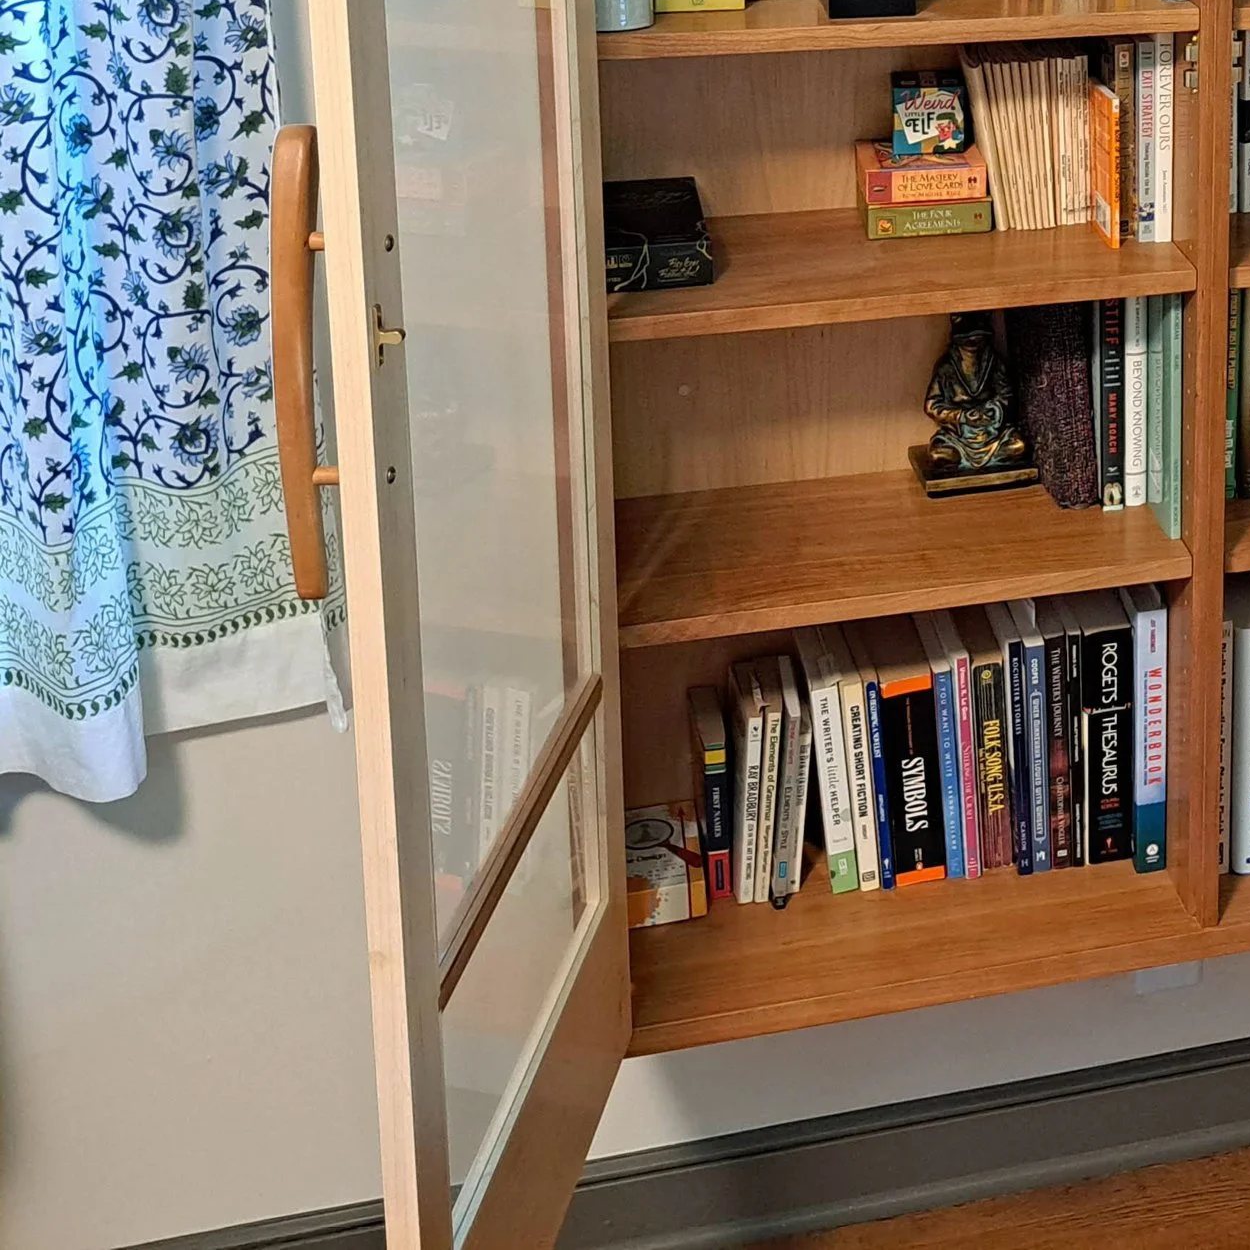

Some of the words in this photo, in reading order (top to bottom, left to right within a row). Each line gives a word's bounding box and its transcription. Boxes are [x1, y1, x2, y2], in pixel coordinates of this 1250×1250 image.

[1142, 70, 1153, 91] EXIT
[1158, 43, 1172, 114] FOREVER
[905, 91, 960, 111] Weird
[1142, 94, 1153, 139] STRATEGY
[905, 111, 935, 135] ELF
[1159, 114, 1173, 151] OURS
[1105, 299, 1119, 344] STIFF
[1132, 361, 1142, 407] BEYOND
[1108, 393, 1117, 419] MARY
[1109, 423, 1118, 454] ROACH
[1132, 411, 1142, 466] KNOWING
[819, 697, 829, 716] THE
[822, 718, 833, 763] WRITER'S
[850, 705, 862, 750] CREATING
[983, 719, 1000, 748] FOLK
[1148, 667, 1163, 785] WONDERBOOK
[854, 751, 866, 782] SHORT
[984, 751, 1002, 781] SONG
[1101, 713, 1118, 795] THESAURUS
[747, 765, 759, 780] RAY
[826, 764, 838, 789] little
[745, 782, 759, 821] BRADBURY
[830, 790, 841, 826] HELPER
[856, 783, 869, 817] FICTION
[901, 756, 929, 832] SYMBOLS
[986, 783, 1005, 815] U.S.A.
